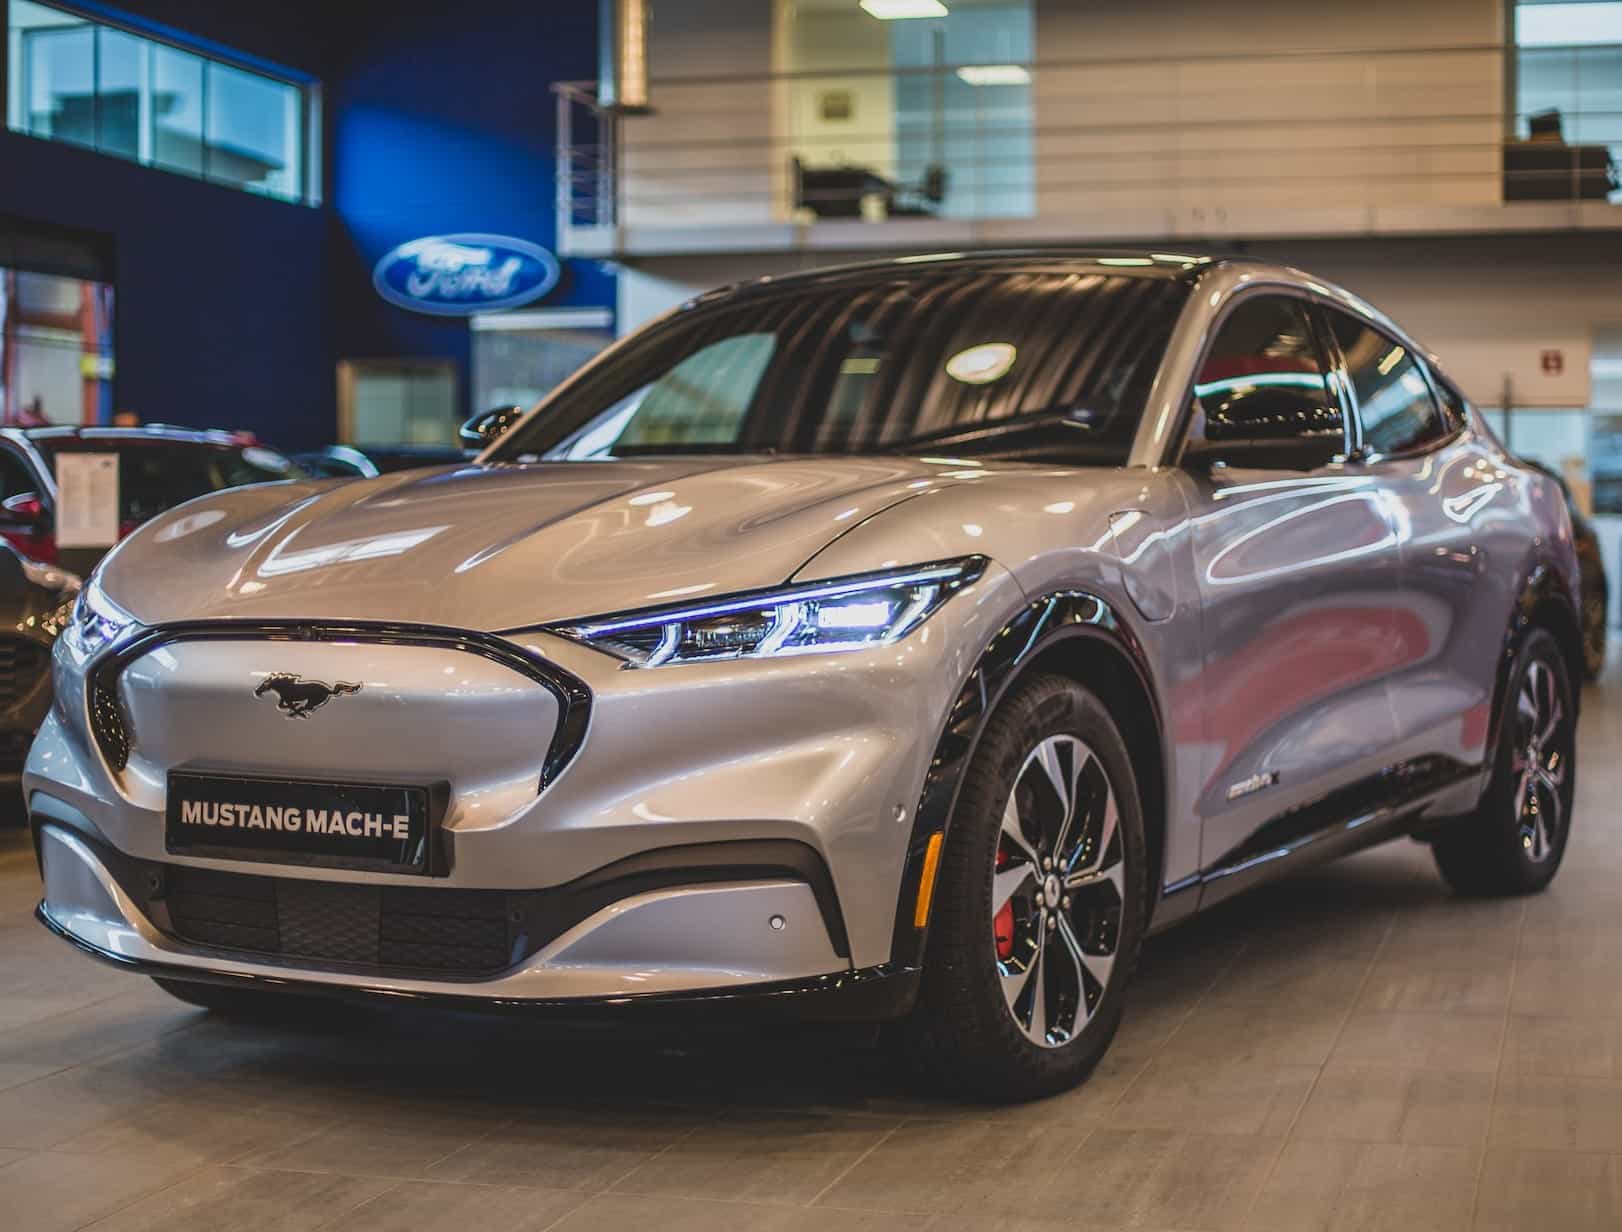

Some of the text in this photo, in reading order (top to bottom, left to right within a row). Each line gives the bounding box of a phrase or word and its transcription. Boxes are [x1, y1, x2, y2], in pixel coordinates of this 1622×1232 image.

[399, 239, 522, 297] Ford
[181, 799, 409, 839] MUSTANG MACH-E
